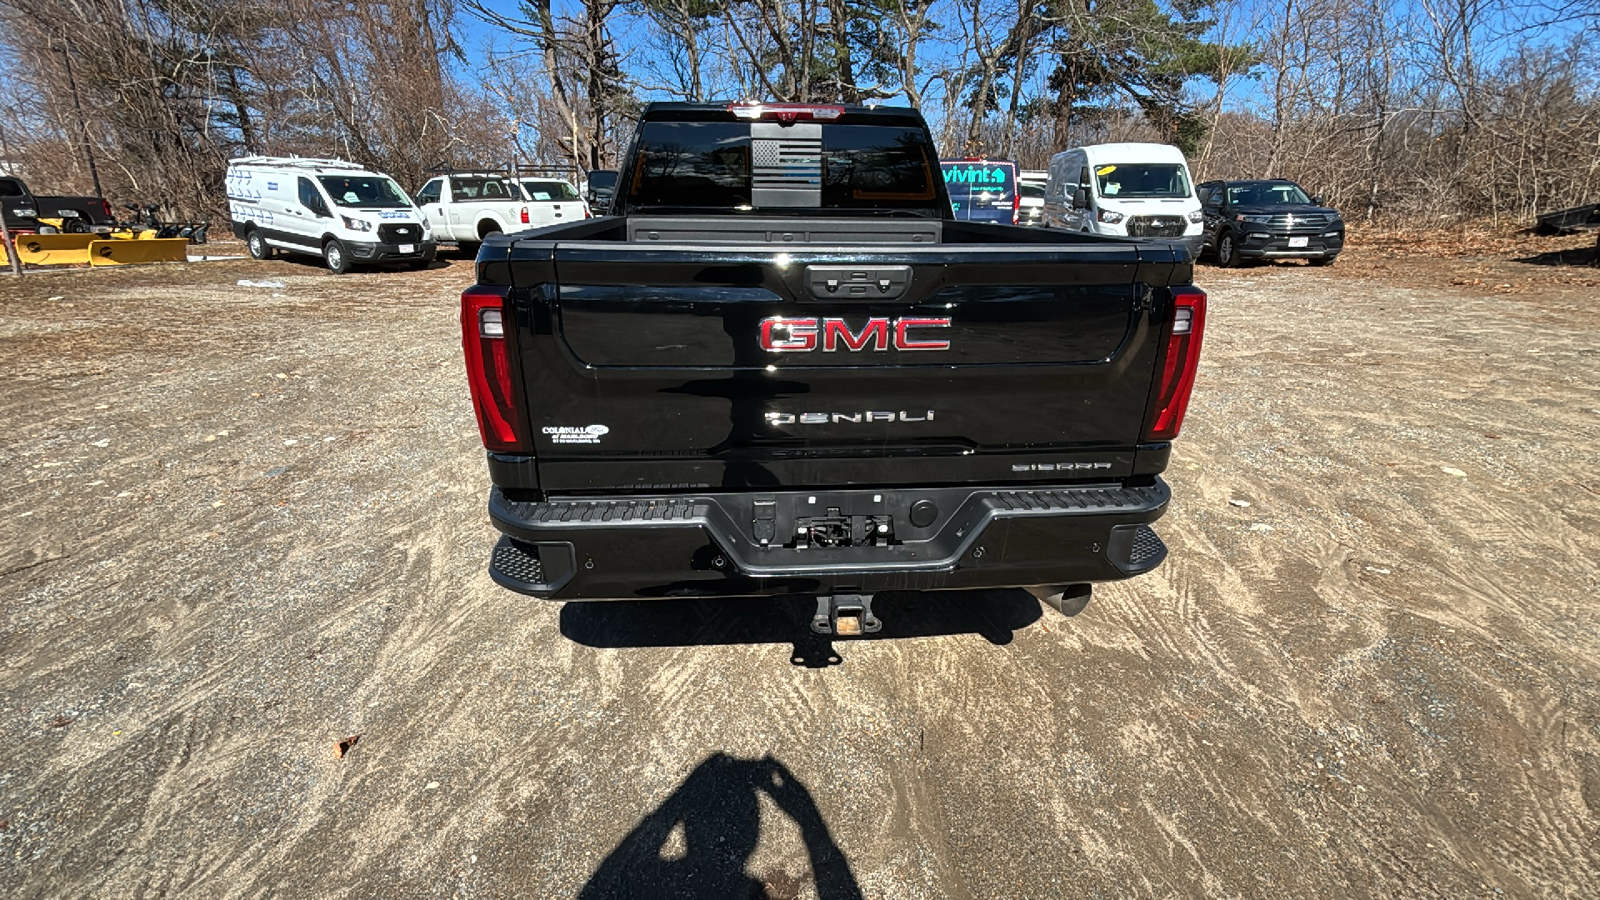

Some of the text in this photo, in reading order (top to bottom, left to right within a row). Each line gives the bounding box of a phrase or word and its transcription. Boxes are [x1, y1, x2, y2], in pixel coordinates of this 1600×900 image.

[942, 165, 990, 183] vivint
[758, 316, 953, 353] GMC
[764, 410, 935, 425] DENALI
[542, 426, 586, 434] COLONIAL
[1011, 462, 1112, 472] SIERRA
